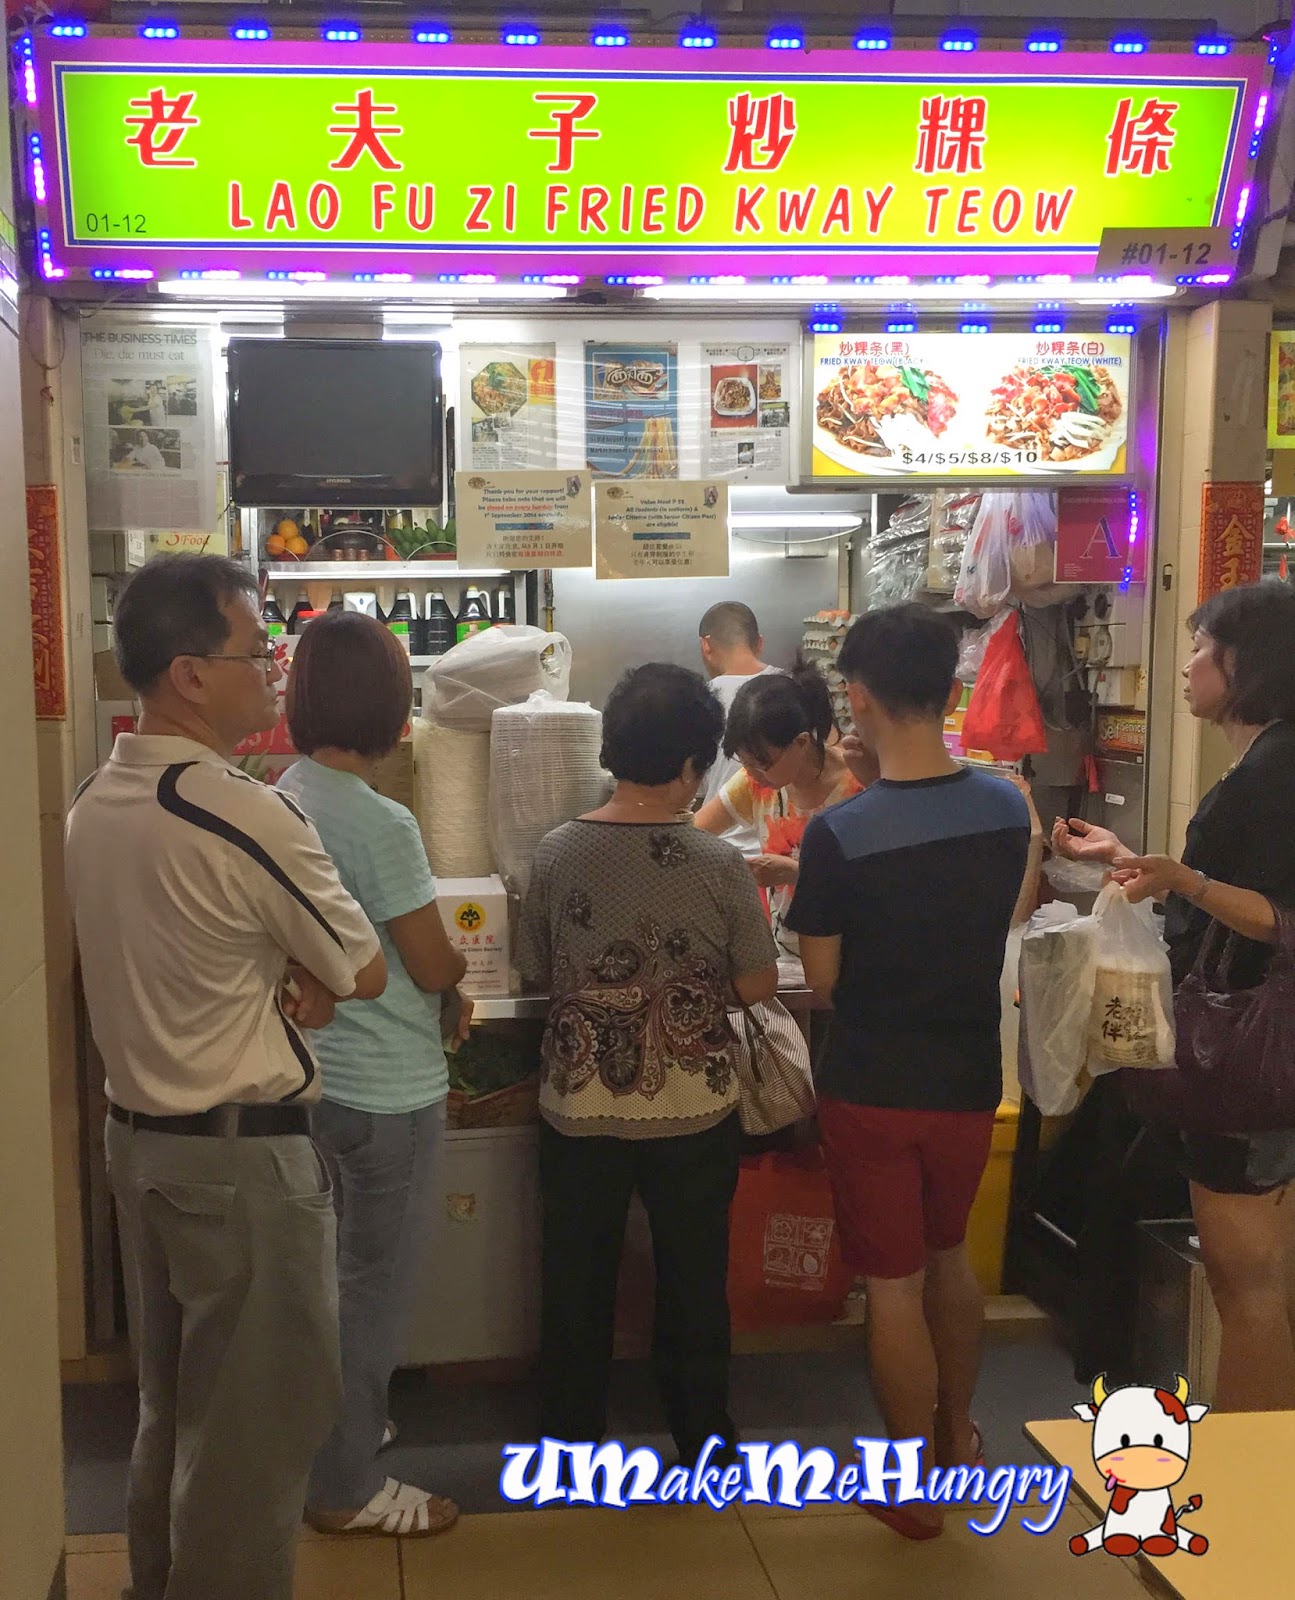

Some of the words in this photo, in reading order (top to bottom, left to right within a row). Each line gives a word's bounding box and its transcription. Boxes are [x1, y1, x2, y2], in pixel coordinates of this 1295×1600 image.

[125, 87, 1180, 175] 老夫子炒粿條
[230, 183, 339, 231] LAO
[374, 185, 434, 231] FU
[465, 186, 516, 232] ZI
[546, 186, 705, 233] FRIED
[734, 185, 894, 235] KWAY
[925, 187, 1075, 235] TEOW
[85, 213, 148, 235] 01-12
[1121, 242, 1212, 265] #01-12
[82, 331, 106, 342] THE
[108, 333, 161, 344] BUSINESS
[163, 334, 198, 345] TIMES
[118, 347, 134, 360] die
[138, 349, 165, 360] must
[168, 351, 185, 361] eat
[838, 341, 910, 356] 炒粿条(黑)
[1035, 341, 1105, 356] 炒粿条(白)
[820, 357, 841, 366] FRIED
[844, 357, 868, 366] KWAY
[1042, 357, 1065, 365] KWAY
[1067, 357, 1090, 365] TEOW
[1091, 357, 1122, 366] (WHITE)
[902, 452, 1037, 465] $4/$5/$8/$10
[1080, 515, 1123, 558] A
[1101, 719, 1120, 740] Self
[1121, 720, 1145, 733] Service
[1101, 996, 1124, 1043] 老伴
